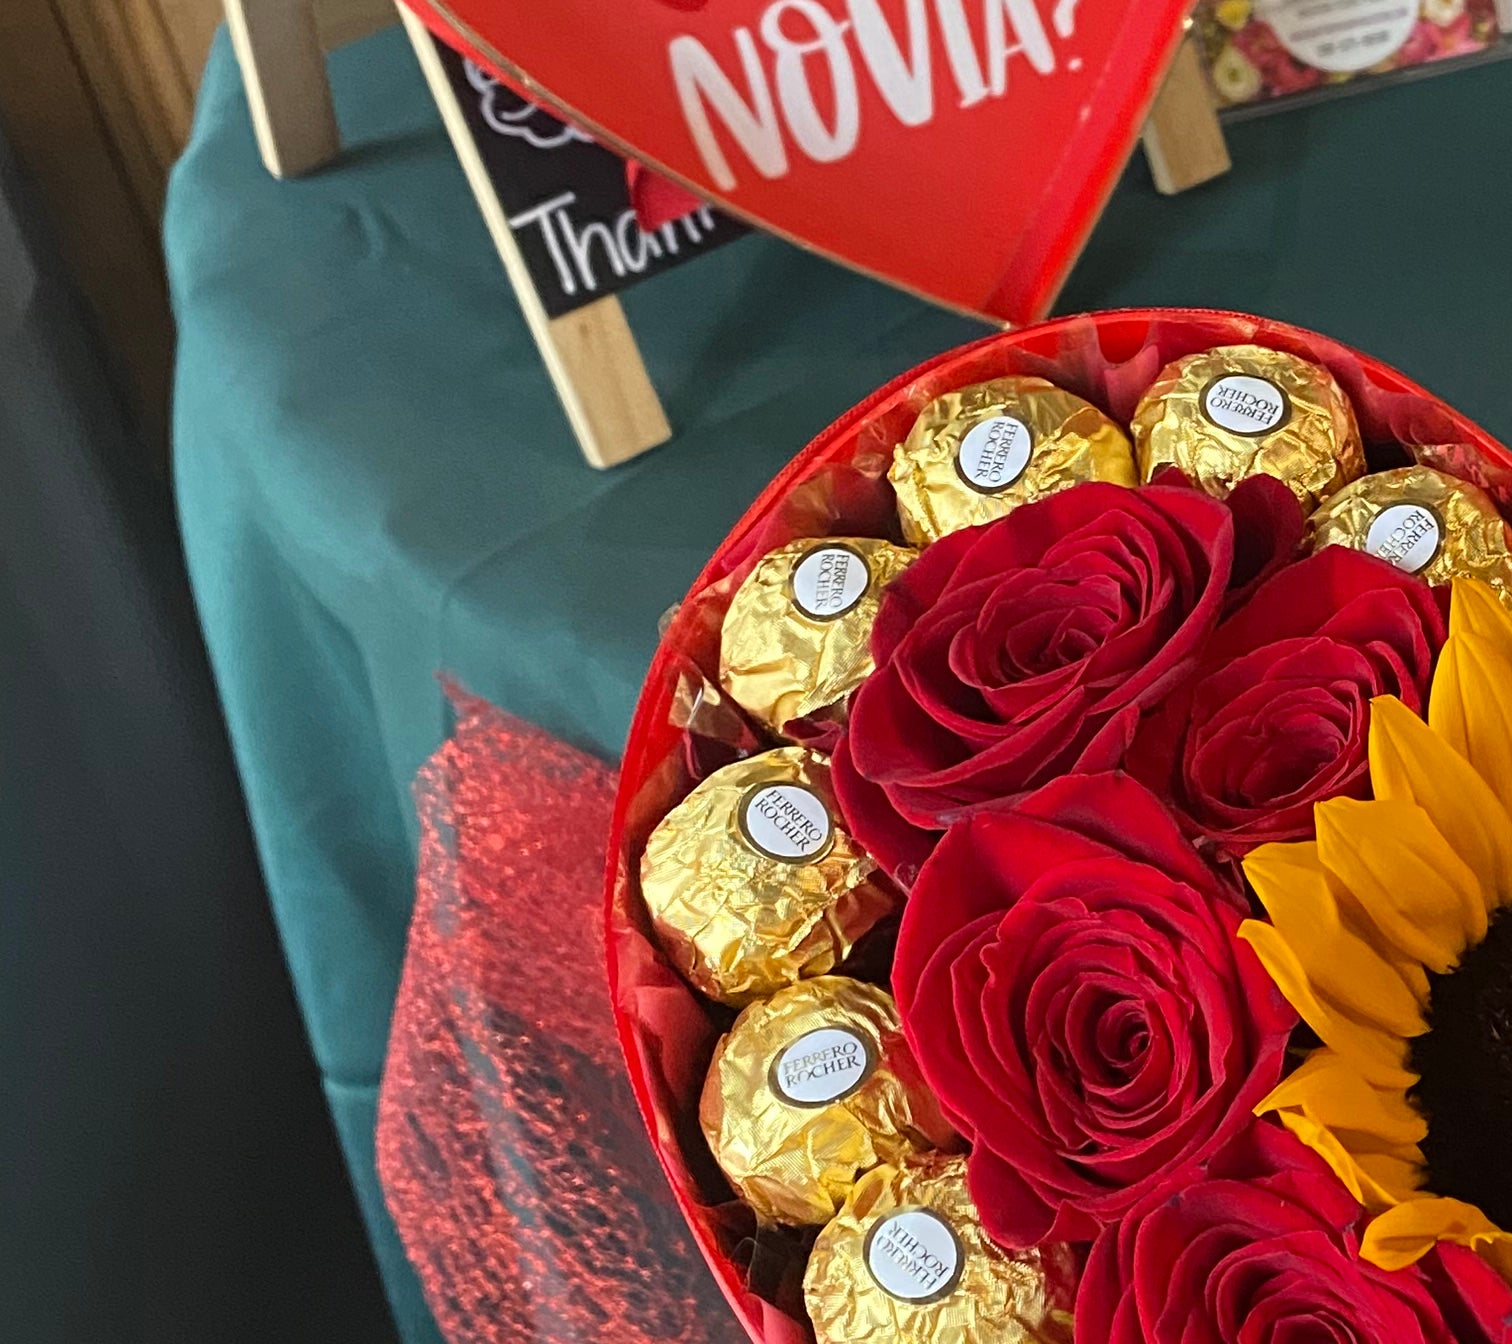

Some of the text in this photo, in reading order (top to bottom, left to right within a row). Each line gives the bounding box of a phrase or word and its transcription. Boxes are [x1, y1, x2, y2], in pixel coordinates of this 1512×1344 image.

[1210, 397, 1272, 425] FERRERO
[1218, 385, 1280, 412] ROCHER
[975, 421, 1006, 479] ROCHER
[989, 422, 1018, 483] FERRERO
[815, 554, 835, 610] ROCHER
[831, 555, 850, 609] FERRERO
[755, 799, 811, 853] ROCHER
[766, 789, 823, 843] FERRERO
[783, 1041, 858, 1075] FERRERO
[785, 1055, 862, 1089] ROCHER
[888, 1221, 949, 1278] ROCHER
